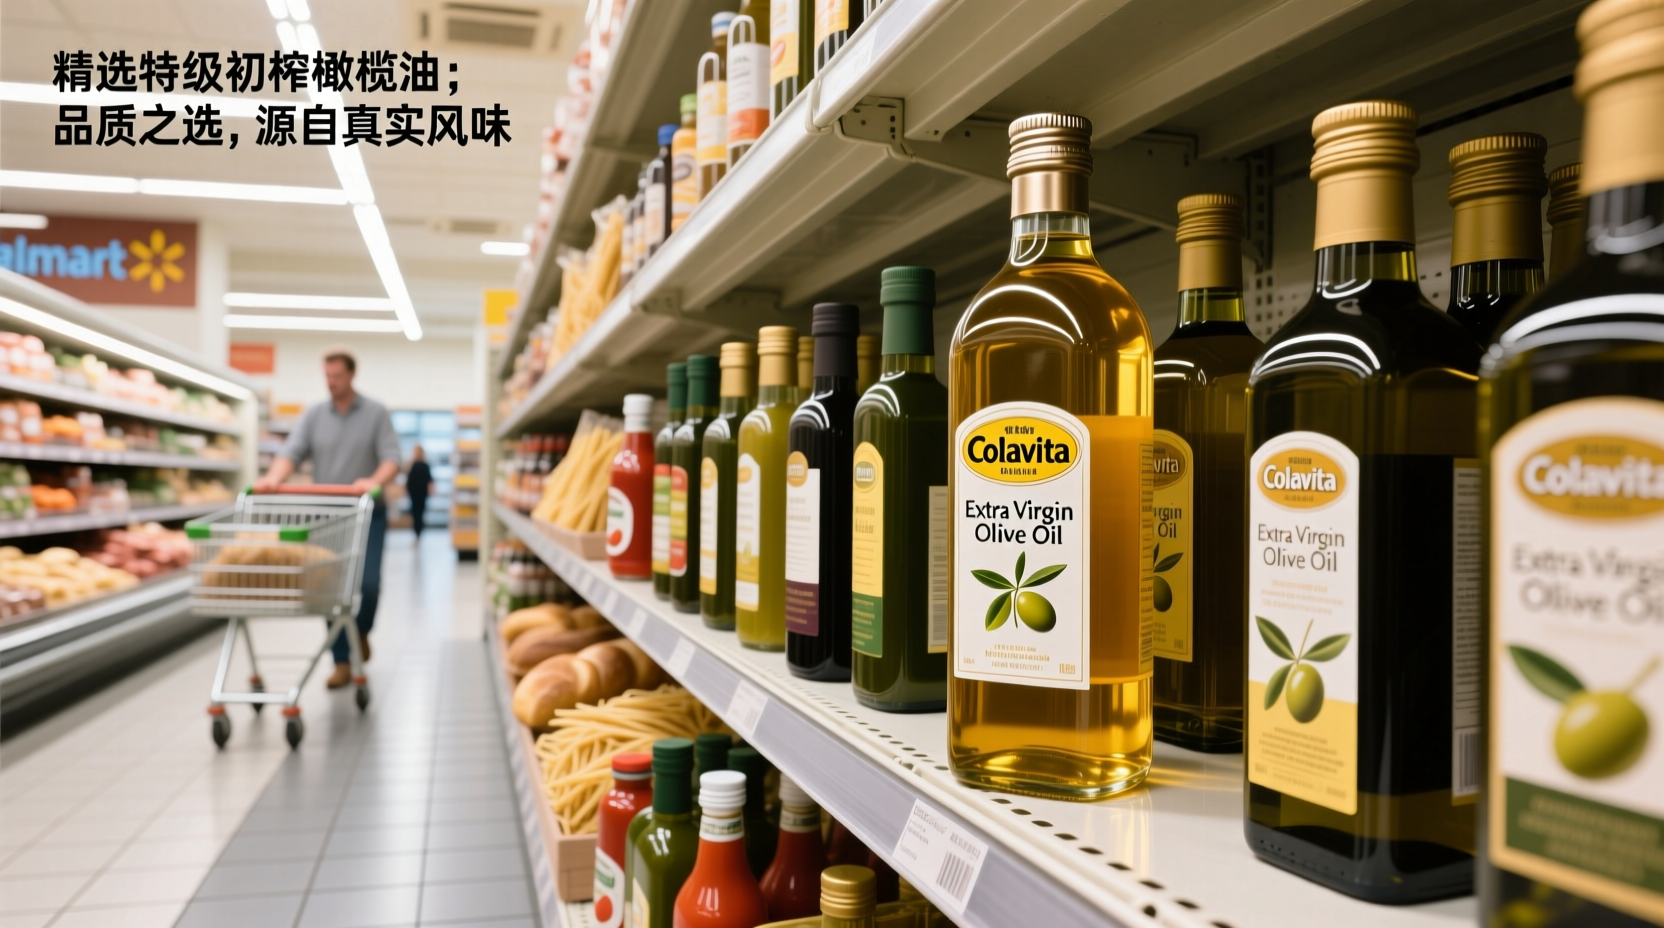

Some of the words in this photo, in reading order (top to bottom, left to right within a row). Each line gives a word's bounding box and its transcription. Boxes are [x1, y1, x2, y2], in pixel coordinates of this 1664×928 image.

[967, 436, 1070, 463] Colavita
[1263, 464, 1337, 492] Colavita
[966, 500, 1009, 519] Extra
[1013, 500, 1074, 524] Virgin
[975, 523, 1026, 544] Olive
[1032, 525, 1062, 545] Oil
[1158, 521, 1177, 538] Oil
[1259, 523, 1292, 543] Extra
[1295, 525, 1345, 551] Virgin
[1264, 547, 1306, 570] Olive
[1311, 550, 1338, 572] Oil
